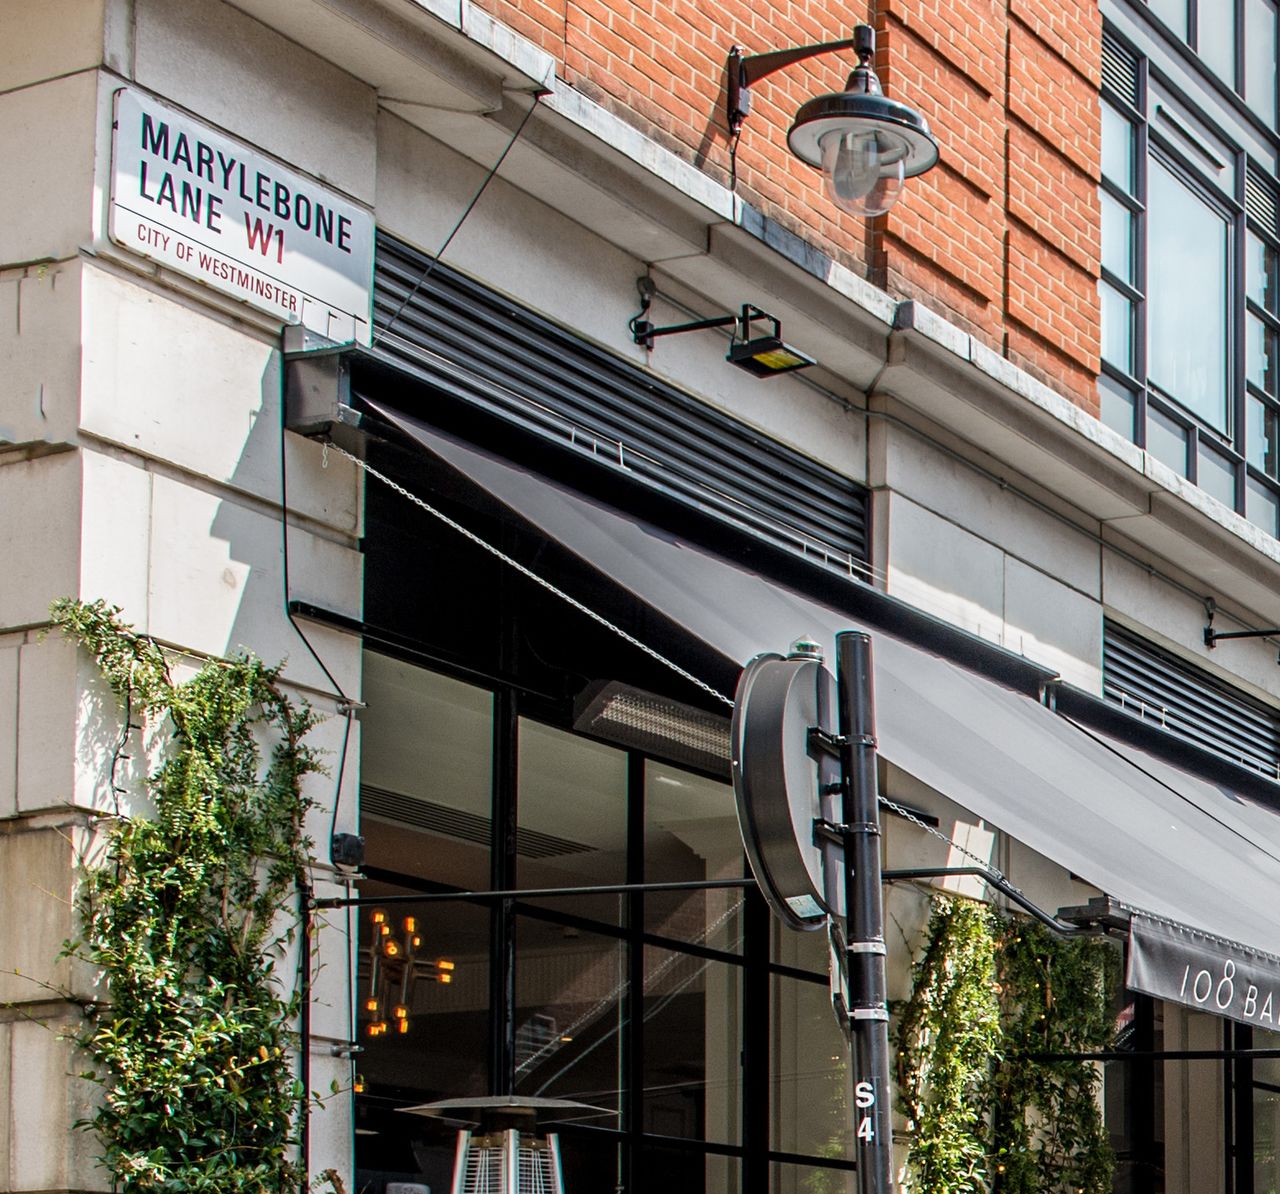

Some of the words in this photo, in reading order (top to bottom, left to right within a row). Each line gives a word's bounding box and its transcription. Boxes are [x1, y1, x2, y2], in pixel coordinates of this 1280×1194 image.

[140, 160, 223, 235] LANE
[243, 210, 285, 264] W1
[141, 112, 352, 254] MARYLEBONE
[137, 223, 170, 252] CITY
[176, 241, 194, 262] OF
[198, 251, 297, 312] WESTMINSTER
[1180, 959, 1236, 1009] 108
